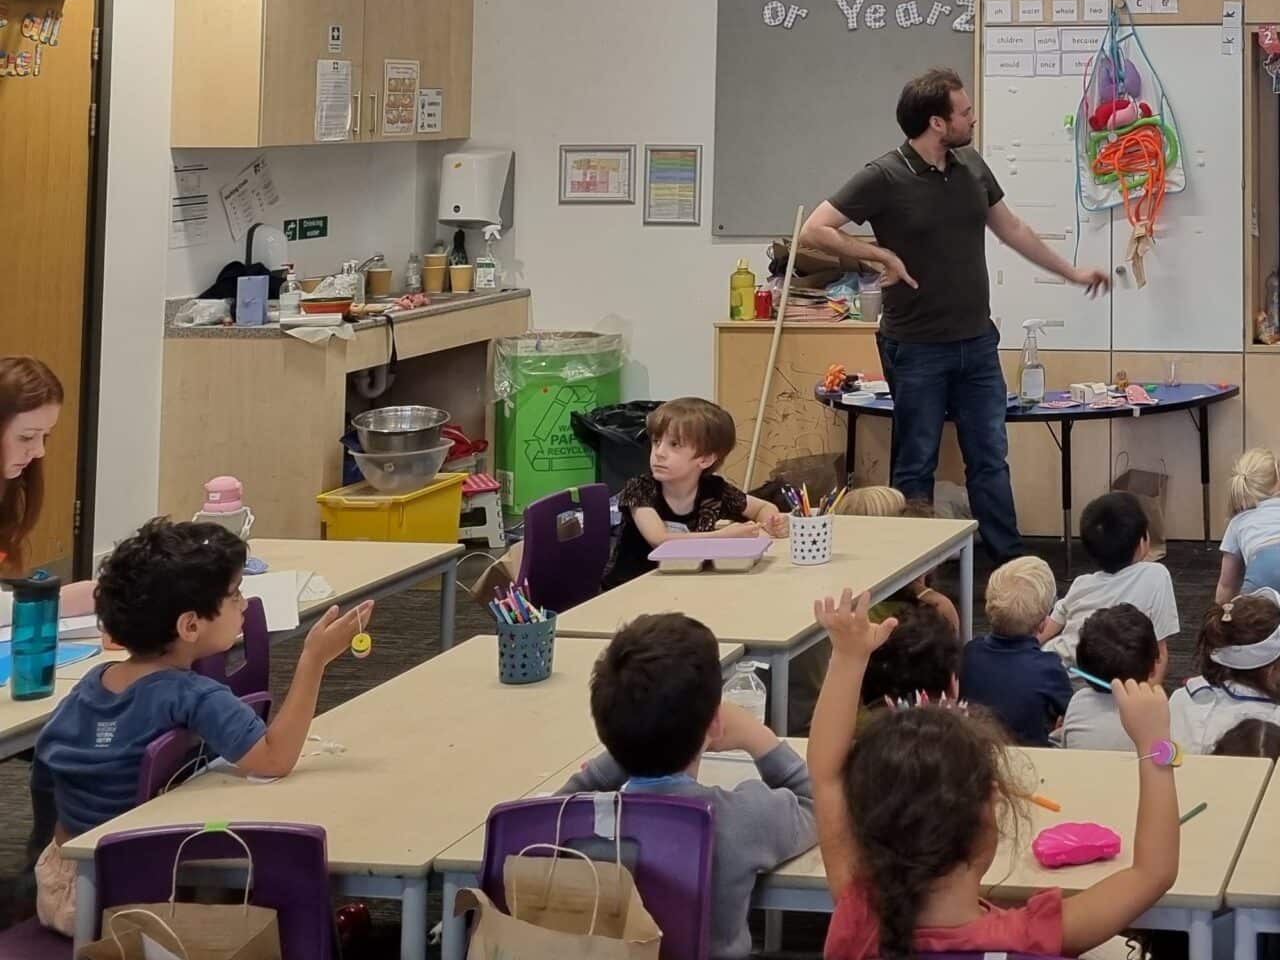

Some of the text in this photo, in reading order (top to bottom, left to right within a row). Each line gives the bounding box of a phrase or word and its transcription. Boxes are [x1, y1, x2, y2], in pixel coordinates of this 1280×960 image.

[1137, 0, 1143, 7] c
[762, 0, 808, 29] or
[1263, 31, 1273, 44] 2
